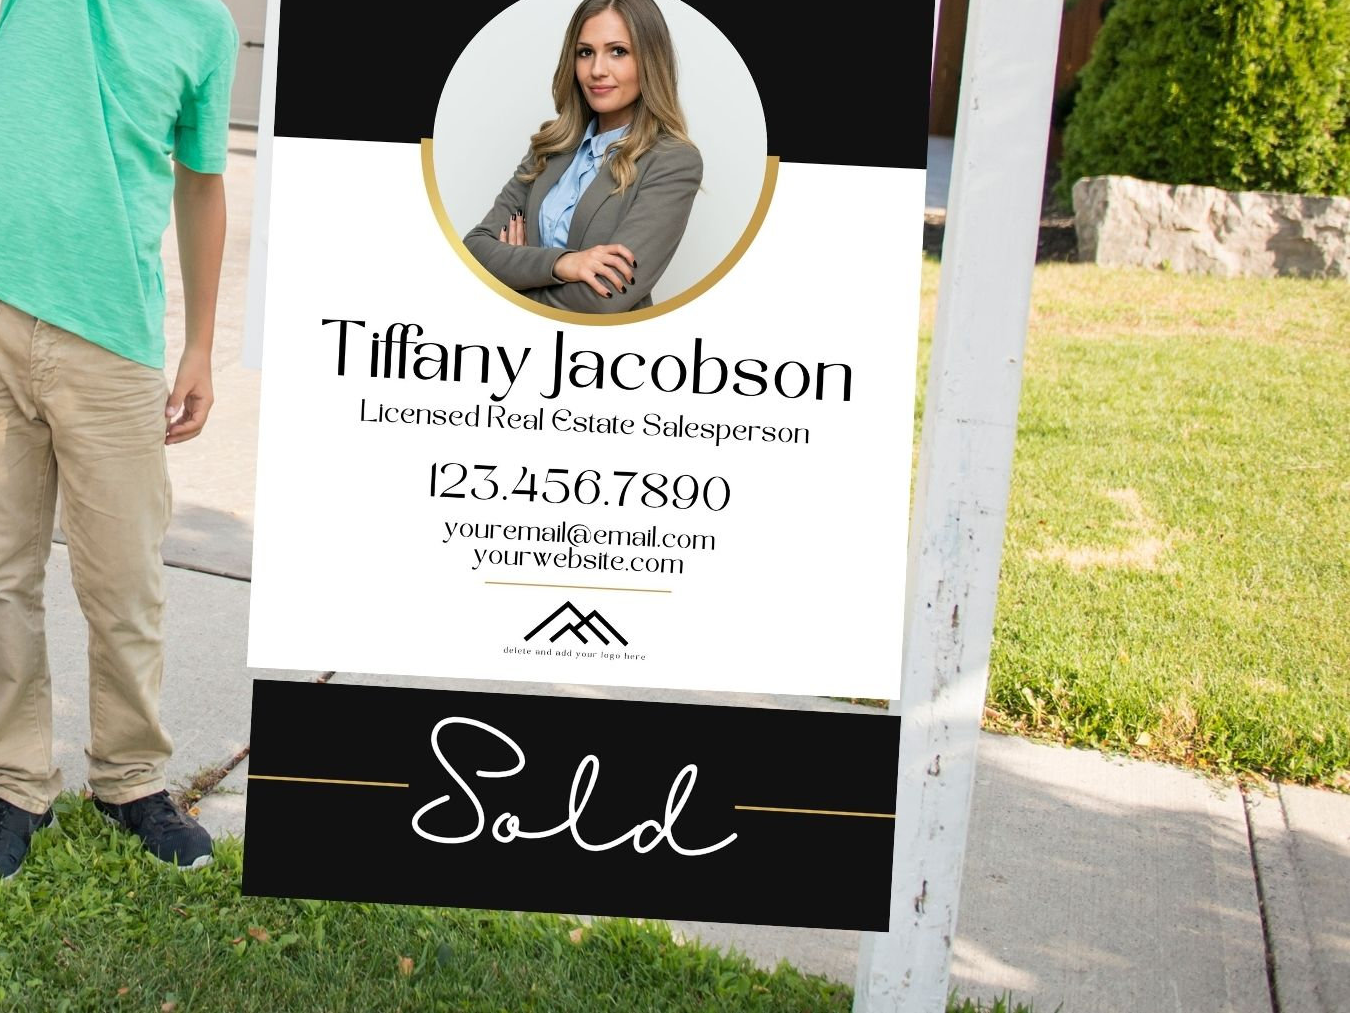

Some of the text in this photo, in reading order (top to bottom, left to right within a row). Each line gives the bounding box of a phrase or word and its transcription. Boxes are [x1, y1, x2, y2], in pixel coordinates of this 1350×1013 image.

[321, 318, 852, 402] Tiffany Jacobson
[360, 398, 810, 447] Licensed Real Estate Salesperson
[430, 462, 731, 512] 123.456.7890
[442, 520, 716, 551] youremail@email.com
[471, 547, 684, 575] yourwebsite.com
[503, 646, 646, 661] delete and add your logo here
[411, 716, 738, 857] Sold
